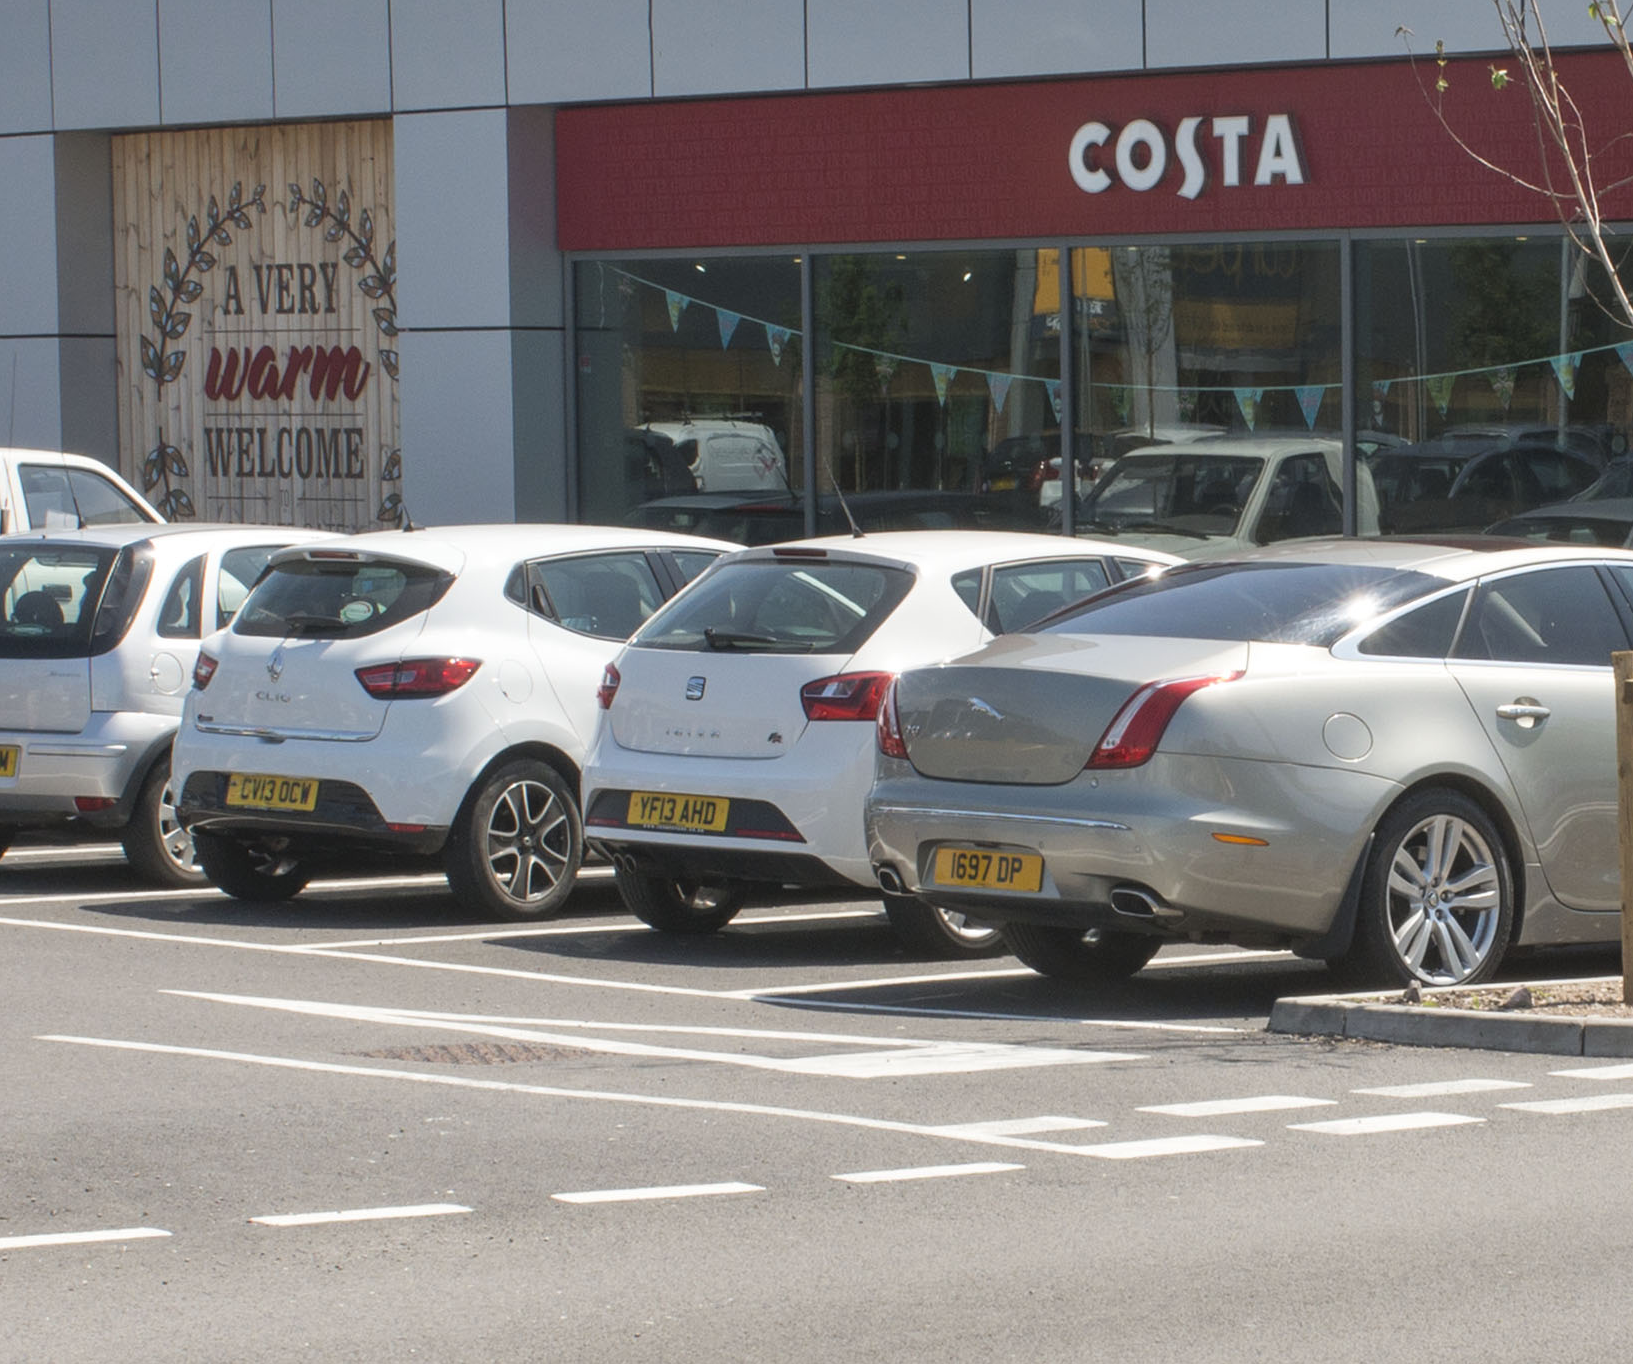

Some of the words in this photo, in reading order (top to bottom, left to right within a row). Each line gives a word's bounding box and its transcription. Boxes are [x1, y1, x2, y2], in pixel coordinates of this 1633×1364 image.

[1069, 113, 1304, 200] COSTA
[224, 264, 244, 315] A
[253, 262, 338, 314] VERY
[204, 345, 370, 401] warm
[204, 427, 365, 479] WELCOME
[256, 691, 291, 703] CLIO
[240, 778, 276, 801] CV13
[279, 780, 312, 805] OCW
[639, 796, 677, 821] YF13
[679, 798, 717, 826] AHD
[950, 852, 993, 881] 1697
[996, 855, 1023, 884] DP
